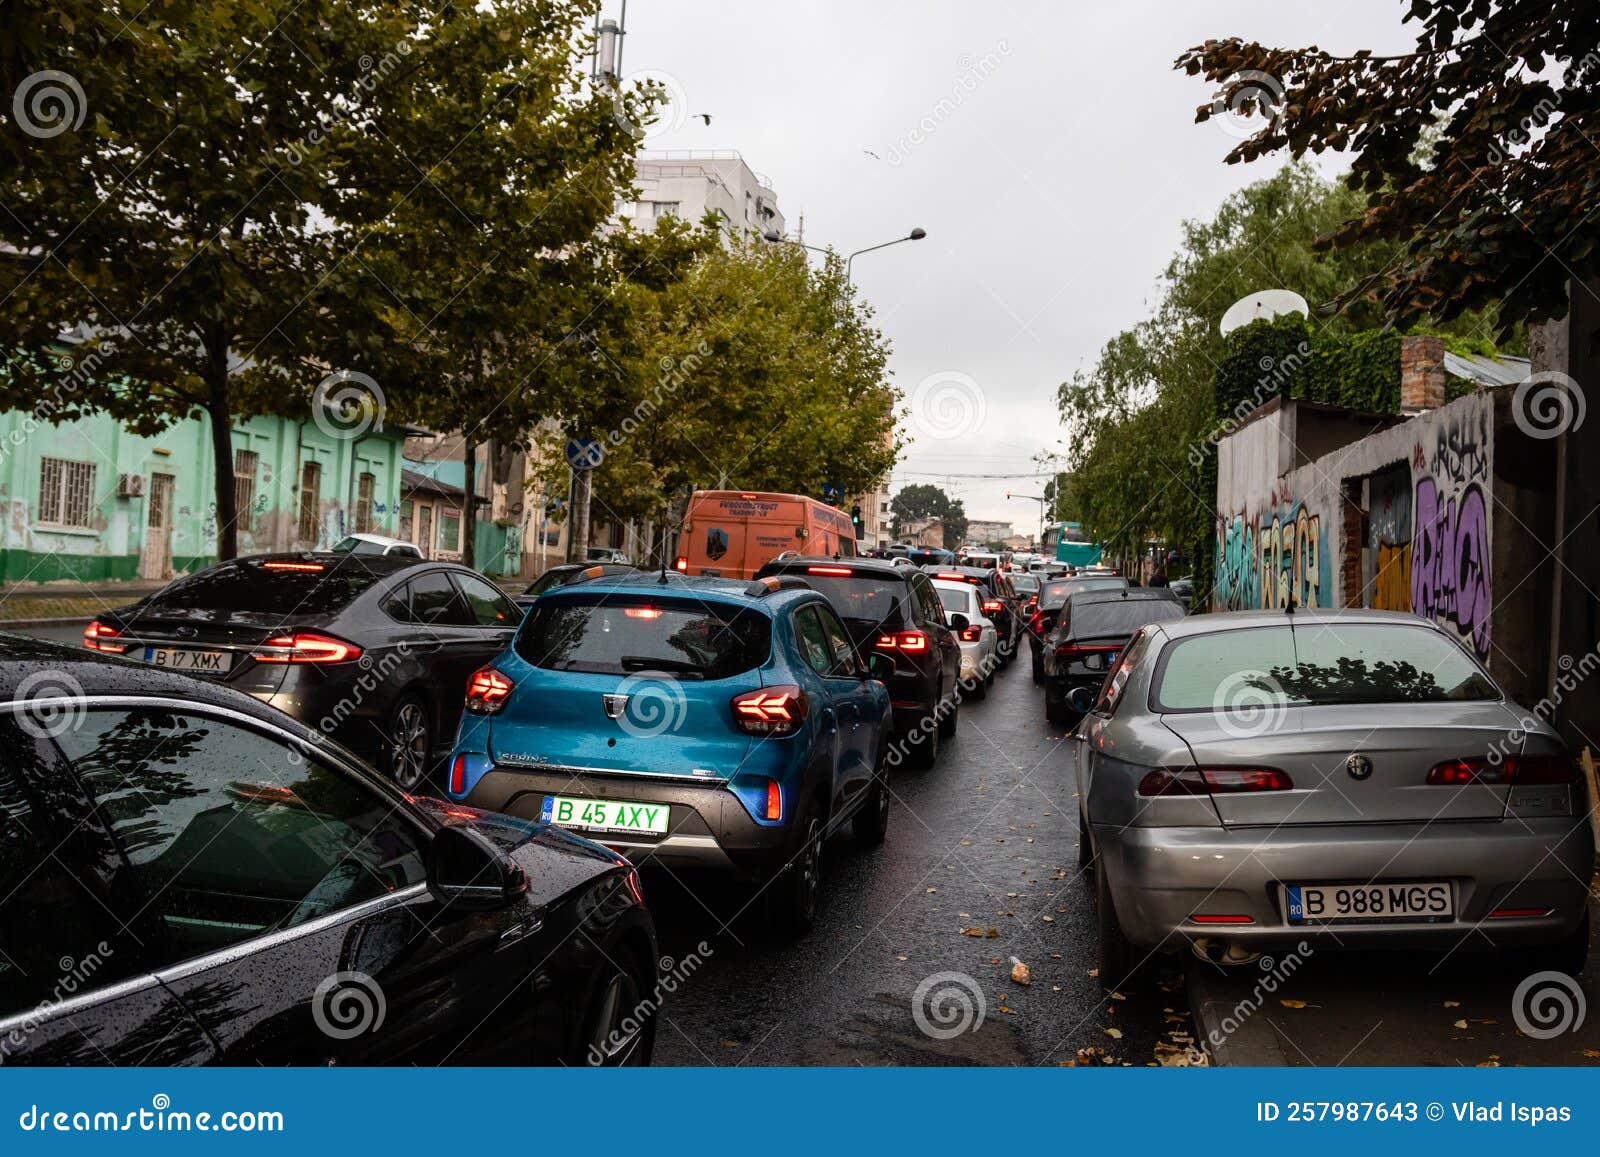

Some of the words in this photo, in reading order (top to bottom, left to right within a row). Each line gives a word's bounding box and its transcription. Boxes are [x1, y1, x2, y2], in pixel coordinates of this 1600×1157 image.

[155, 651, 166, 666] B
[172, 652, 185, 667] 17
[190, 652, 222, 670] XMX
[557, 801, 574, 822] B
[581, 803, 606, 824] 45
[614, 806, 659, 829] AXY
[1290, 904, 1302, 915] RO
[1305, 890, 1325, 915] B
[1335, 888, 1385, 914] 988
[1388, 887, 1448, 913] MGS
